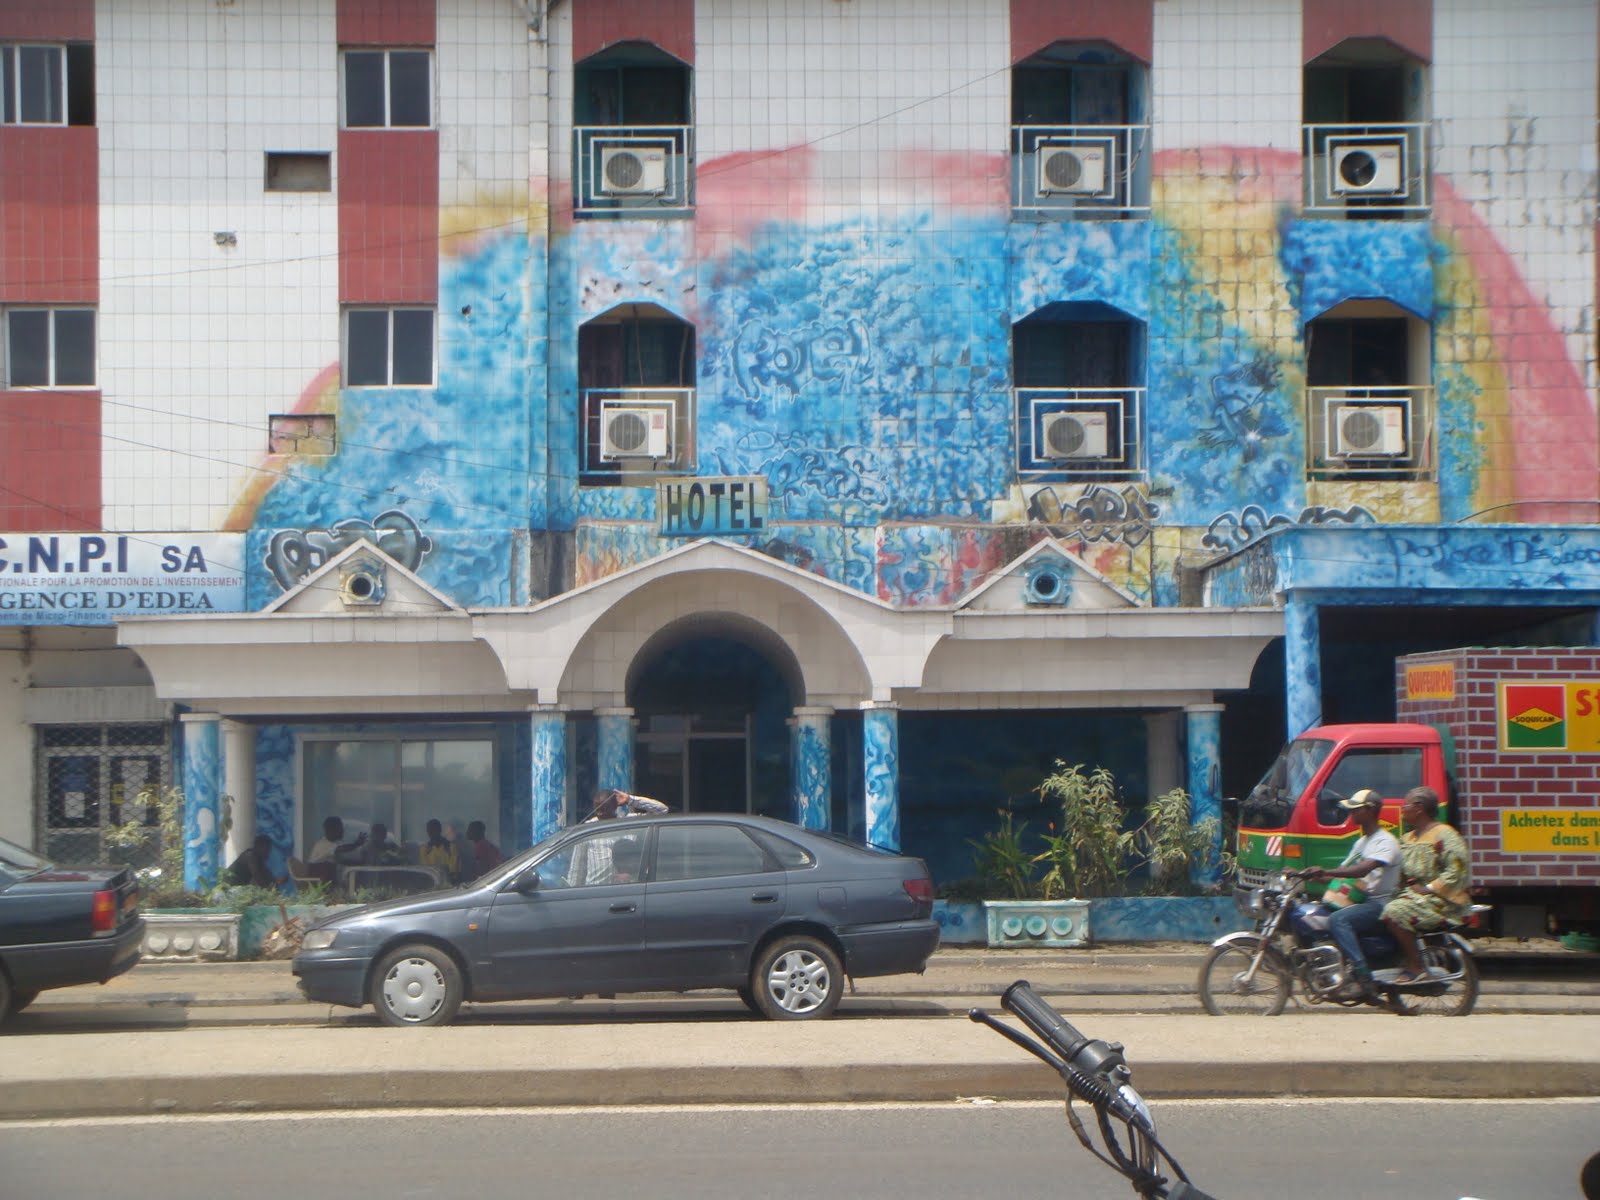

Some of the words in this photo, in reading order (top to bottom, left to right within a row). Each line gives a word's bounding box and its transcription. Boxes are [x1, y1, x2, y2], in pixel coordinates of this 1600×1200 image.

[666, 482, 763, 530] HOTEL
[161, 545, 208, 573] SA
[41, 577, 67, 587] POUR
[70, 577, 81, 587] LA
[84, 577, 139, 587] PROMOTION
[142, 577, 155, 587] DE
[156, 577, 243, 587] L'INVESTISSEMENT
[0, 592, 98, 609] GENCE
[1515, 715, 1555, 723] SOQUICAM
[1508, 813, 1565, 827] Achetez
[1570, 811, 1600, 827] dan
[1552, 830, 1589, 846] dans
